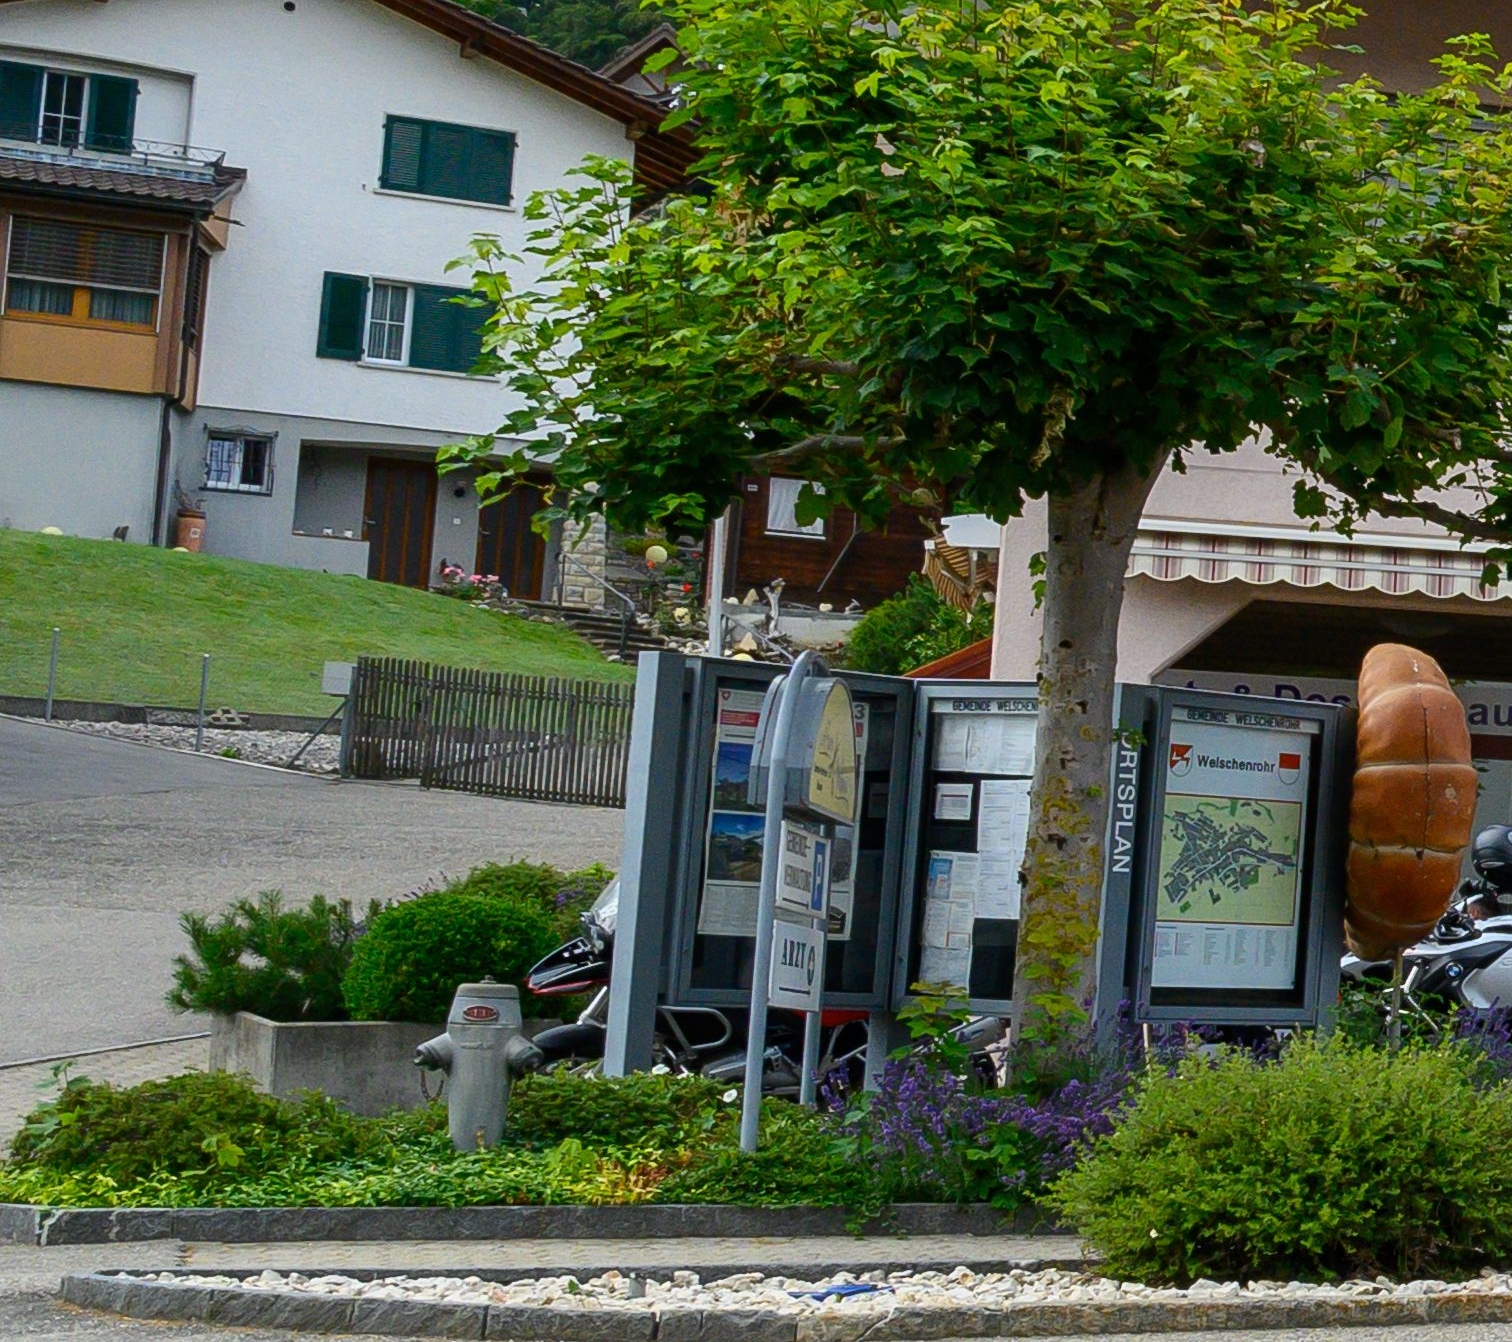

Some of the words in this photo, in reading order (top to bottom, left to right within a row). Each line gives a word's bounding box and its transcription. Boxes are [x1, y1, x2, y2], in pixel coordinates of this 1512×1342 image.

[952, 700, 992, 711] GEMEINDE
[997, 700, 1038, 712] WELSCHEN
[1186, 709, 1229, 724] GEMEINDE
[1197, 754, 1276, 773] Welschenrohr
[781, 938, 807, 970] ARZT
